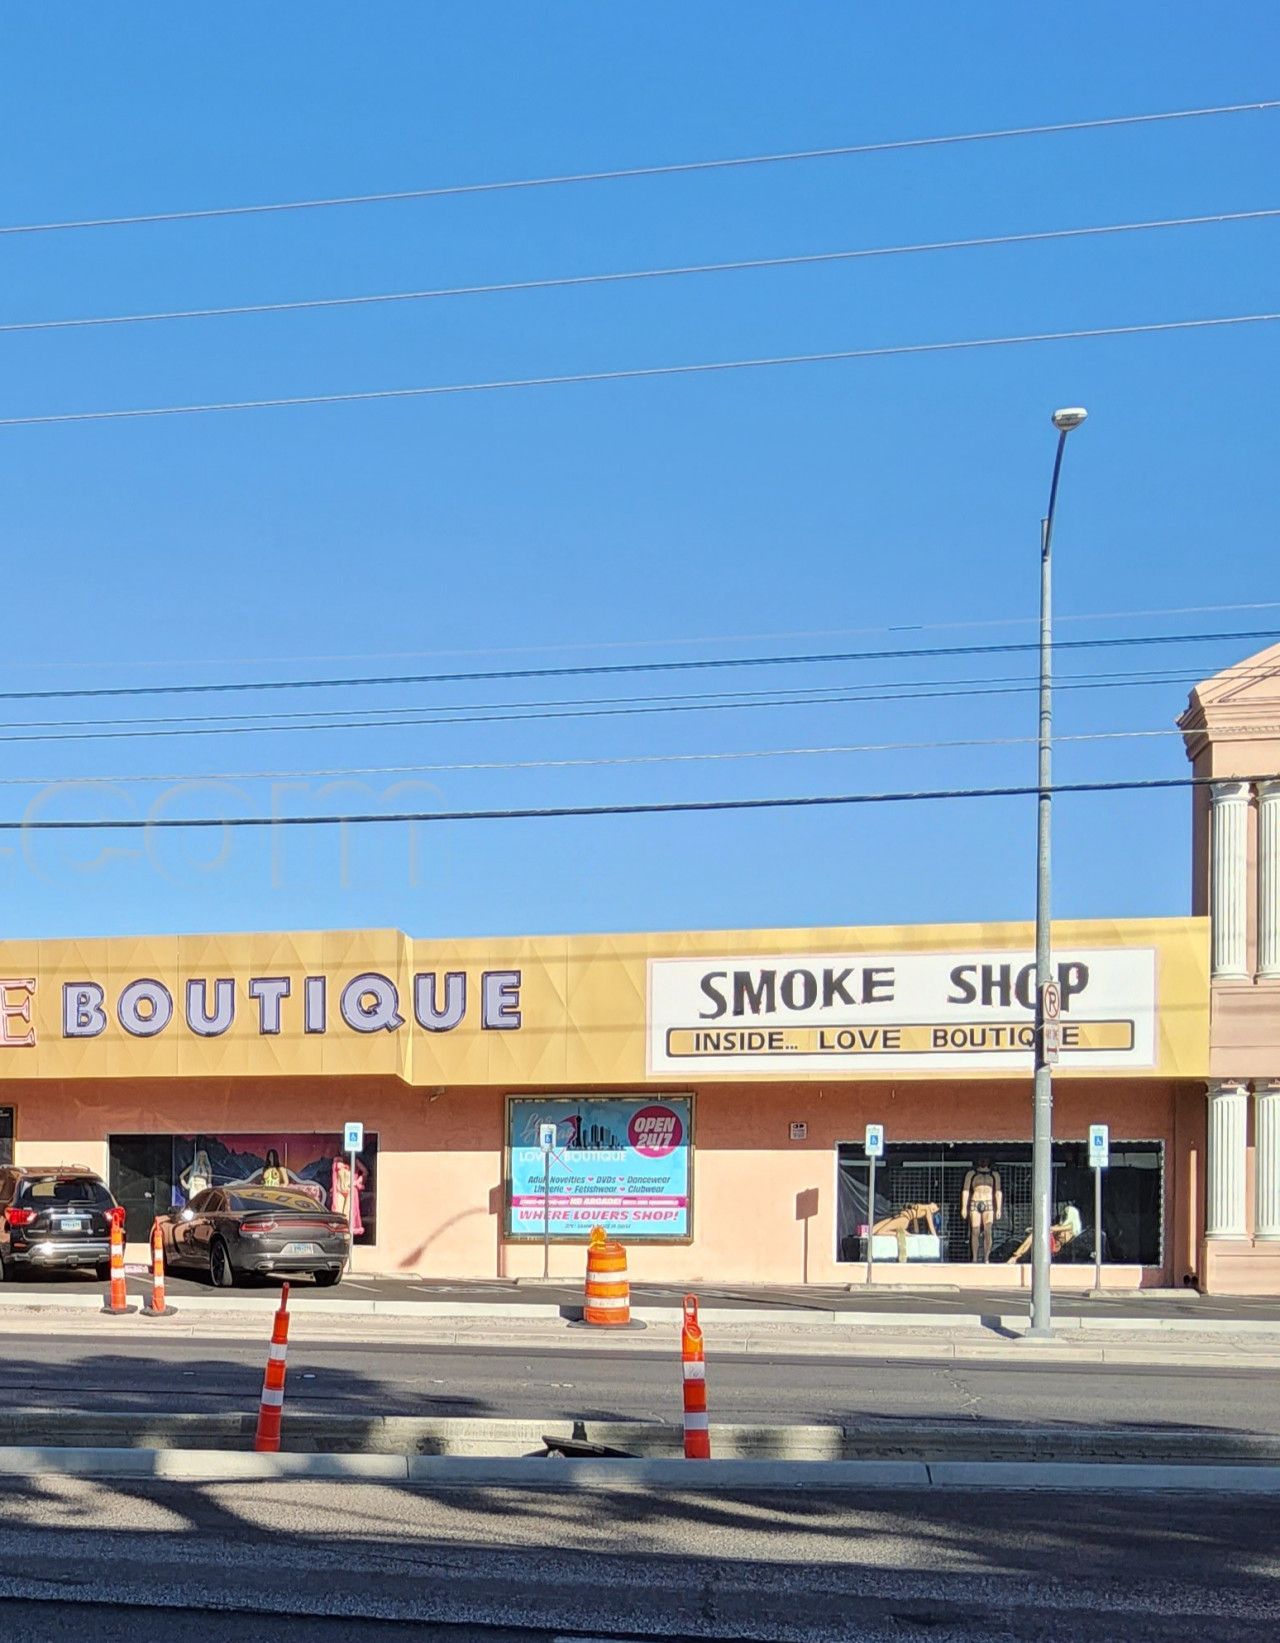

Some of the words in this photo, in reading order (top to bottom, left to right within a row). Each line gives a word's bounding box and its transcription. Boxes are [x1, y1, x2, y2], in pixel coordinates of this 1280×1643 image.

[699, 967, 895, 1019] SMOKE
[62, 970, 521, 1038] BOUTIQUE
[819, 1029, 901, 1049] LOVE
[933, 1026, 1079, 1048] BOUTIQE
[634, 1117, 676, 1133] OPEN
[638, 1133, 673, 1151] 24/7
[564, 1151, 627, 1162] BOUTIQUE
[574, 1211, 629, 1220] LOVERS
[633, 1211, 679, 1220] SHOP!
